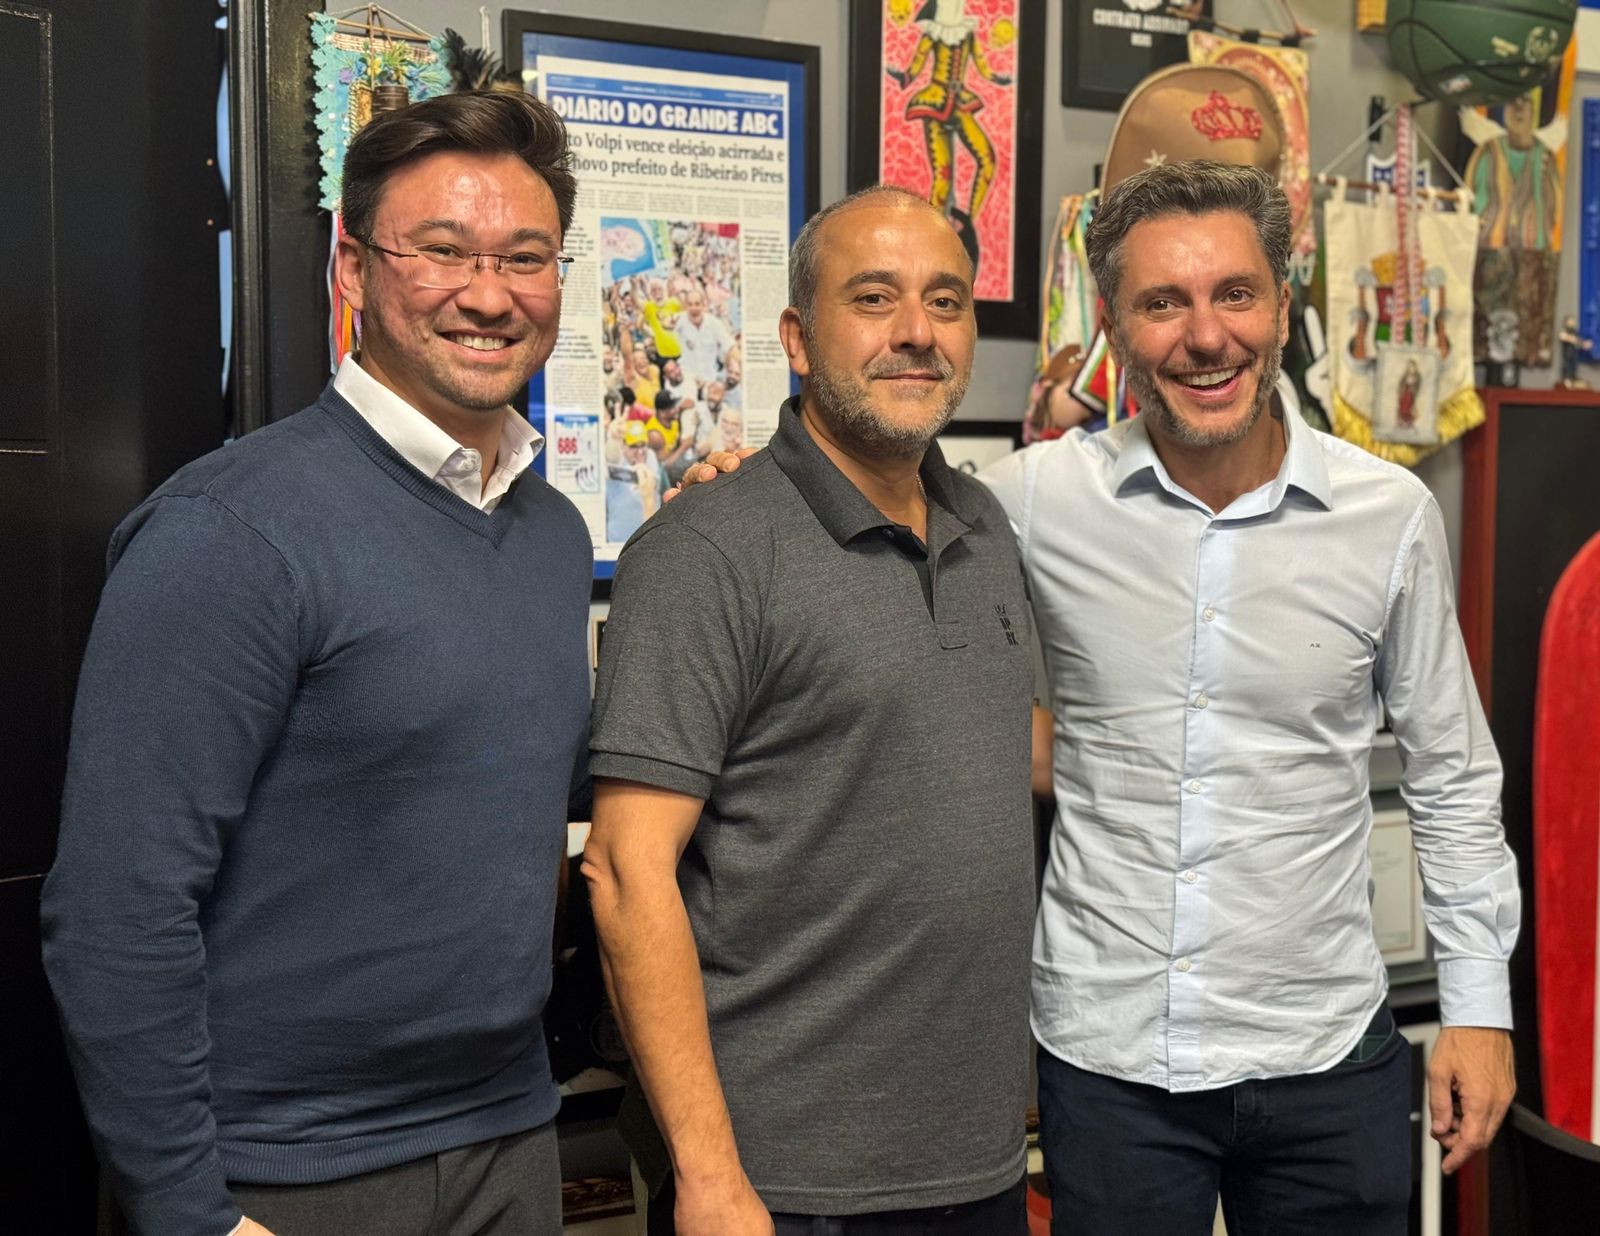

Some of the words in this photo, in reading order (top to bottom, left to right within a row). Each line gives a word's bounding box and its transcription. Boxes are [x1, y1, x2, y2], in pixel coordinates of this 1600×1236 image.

[628, 102, 657, 126] DO
[660, 105, 739, 133] GRANDE
[741, 111, 779, 136] ABC
[567, 133, 582, 147] to
[585, 132, 622, 154] Volpi
[626, 139, 665, 153] vence
[668, 139, 716, 161] eleição
[718, 142, 774, 161] acirrada
[777, 150, 785, 162] e
[573, 157, 608, 172] novo
[612, 158, 667, 177] prefeito
[670, 160, 687, 177] de
[690, 162, 748, 181] Ribeirão
[751, 166, 785, 184] Pires
